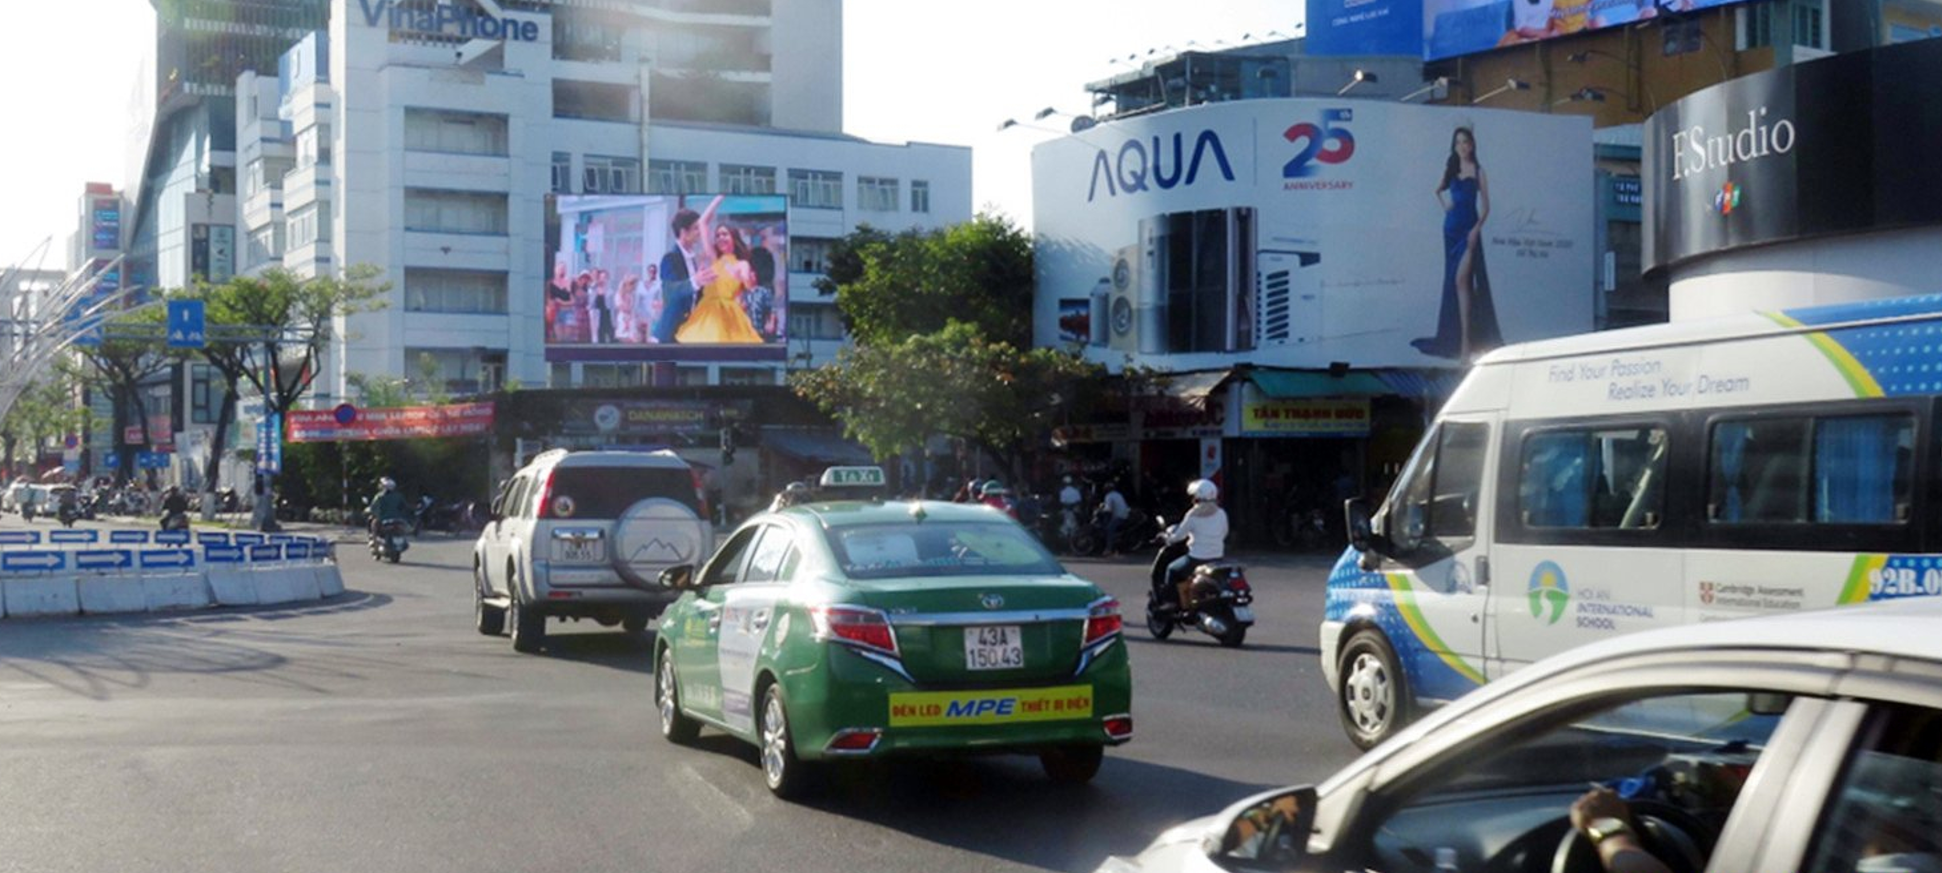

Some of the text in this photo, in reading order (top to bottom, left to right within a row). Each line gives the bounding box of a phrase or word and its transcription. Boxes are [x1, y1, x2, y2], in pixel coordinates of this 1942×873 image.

[360, 0, 539, 42] VinaPhone
[1283, 109, 1355, 179] 25
[1673, 106, 1795, 180] F.Studio
[1088, 129, 1236, 202] AQUA
[1283, 180, 1354, 190] ANNIVERSARY
[1549, 358, 1661, 382] Find Your Passion
[1608, 374, 1750, 400] Realize Your Dream
[1868, 567, 1942, 595] 92B.0
[1576, 616, 1616, 630] SCHOOL
[1577, 603, 1654, 618] INTERNATIONAL
[978, 627, 1008, 646] 43A
[920, 704, 942, 717] LED
[945, 698, 1017, 718] MPE
